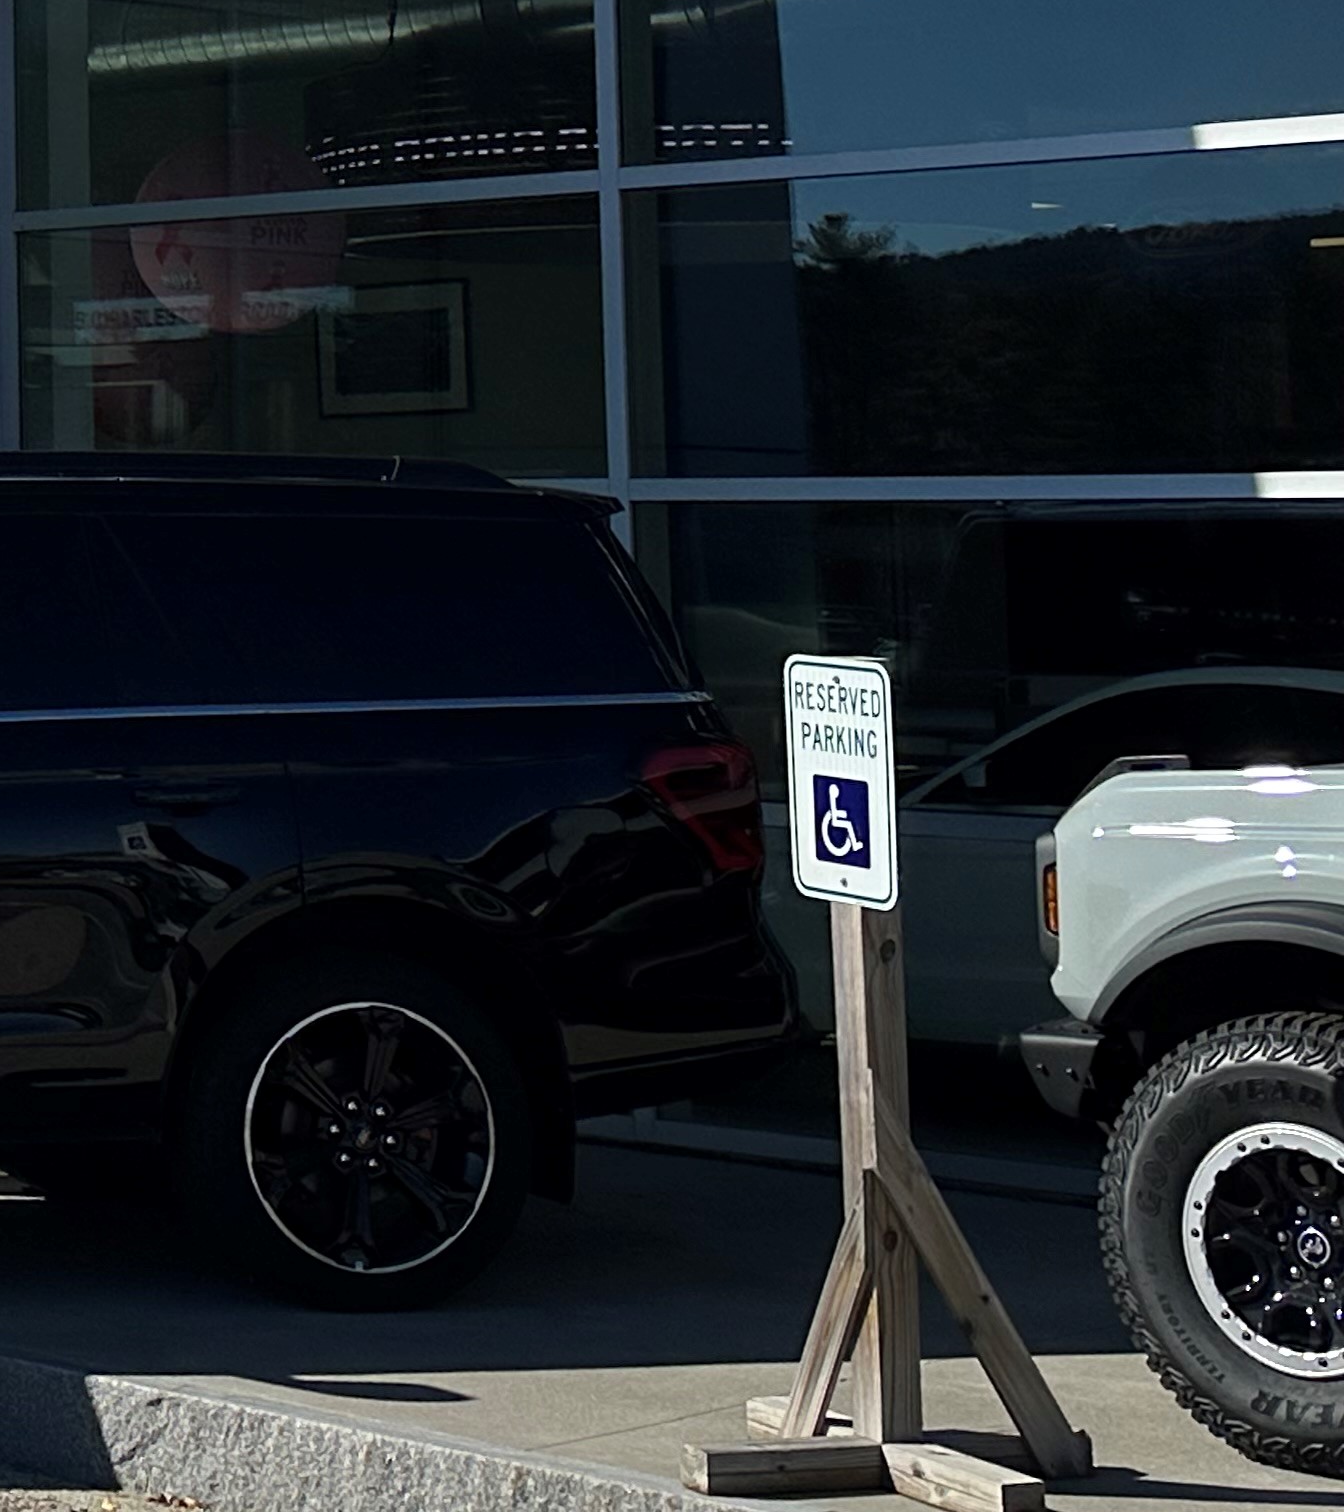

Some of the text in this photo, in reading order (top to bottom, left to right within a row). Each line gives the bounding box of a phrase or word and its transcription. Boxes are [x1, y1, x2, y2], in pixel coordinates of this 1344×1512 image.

[250, 224, 308, 246] PINK
[794, 681, 881, 717] RESERVED
[801, 722, 878, 759] PARKING
[1156, 1293, 1228, 1384] TERRITORY
